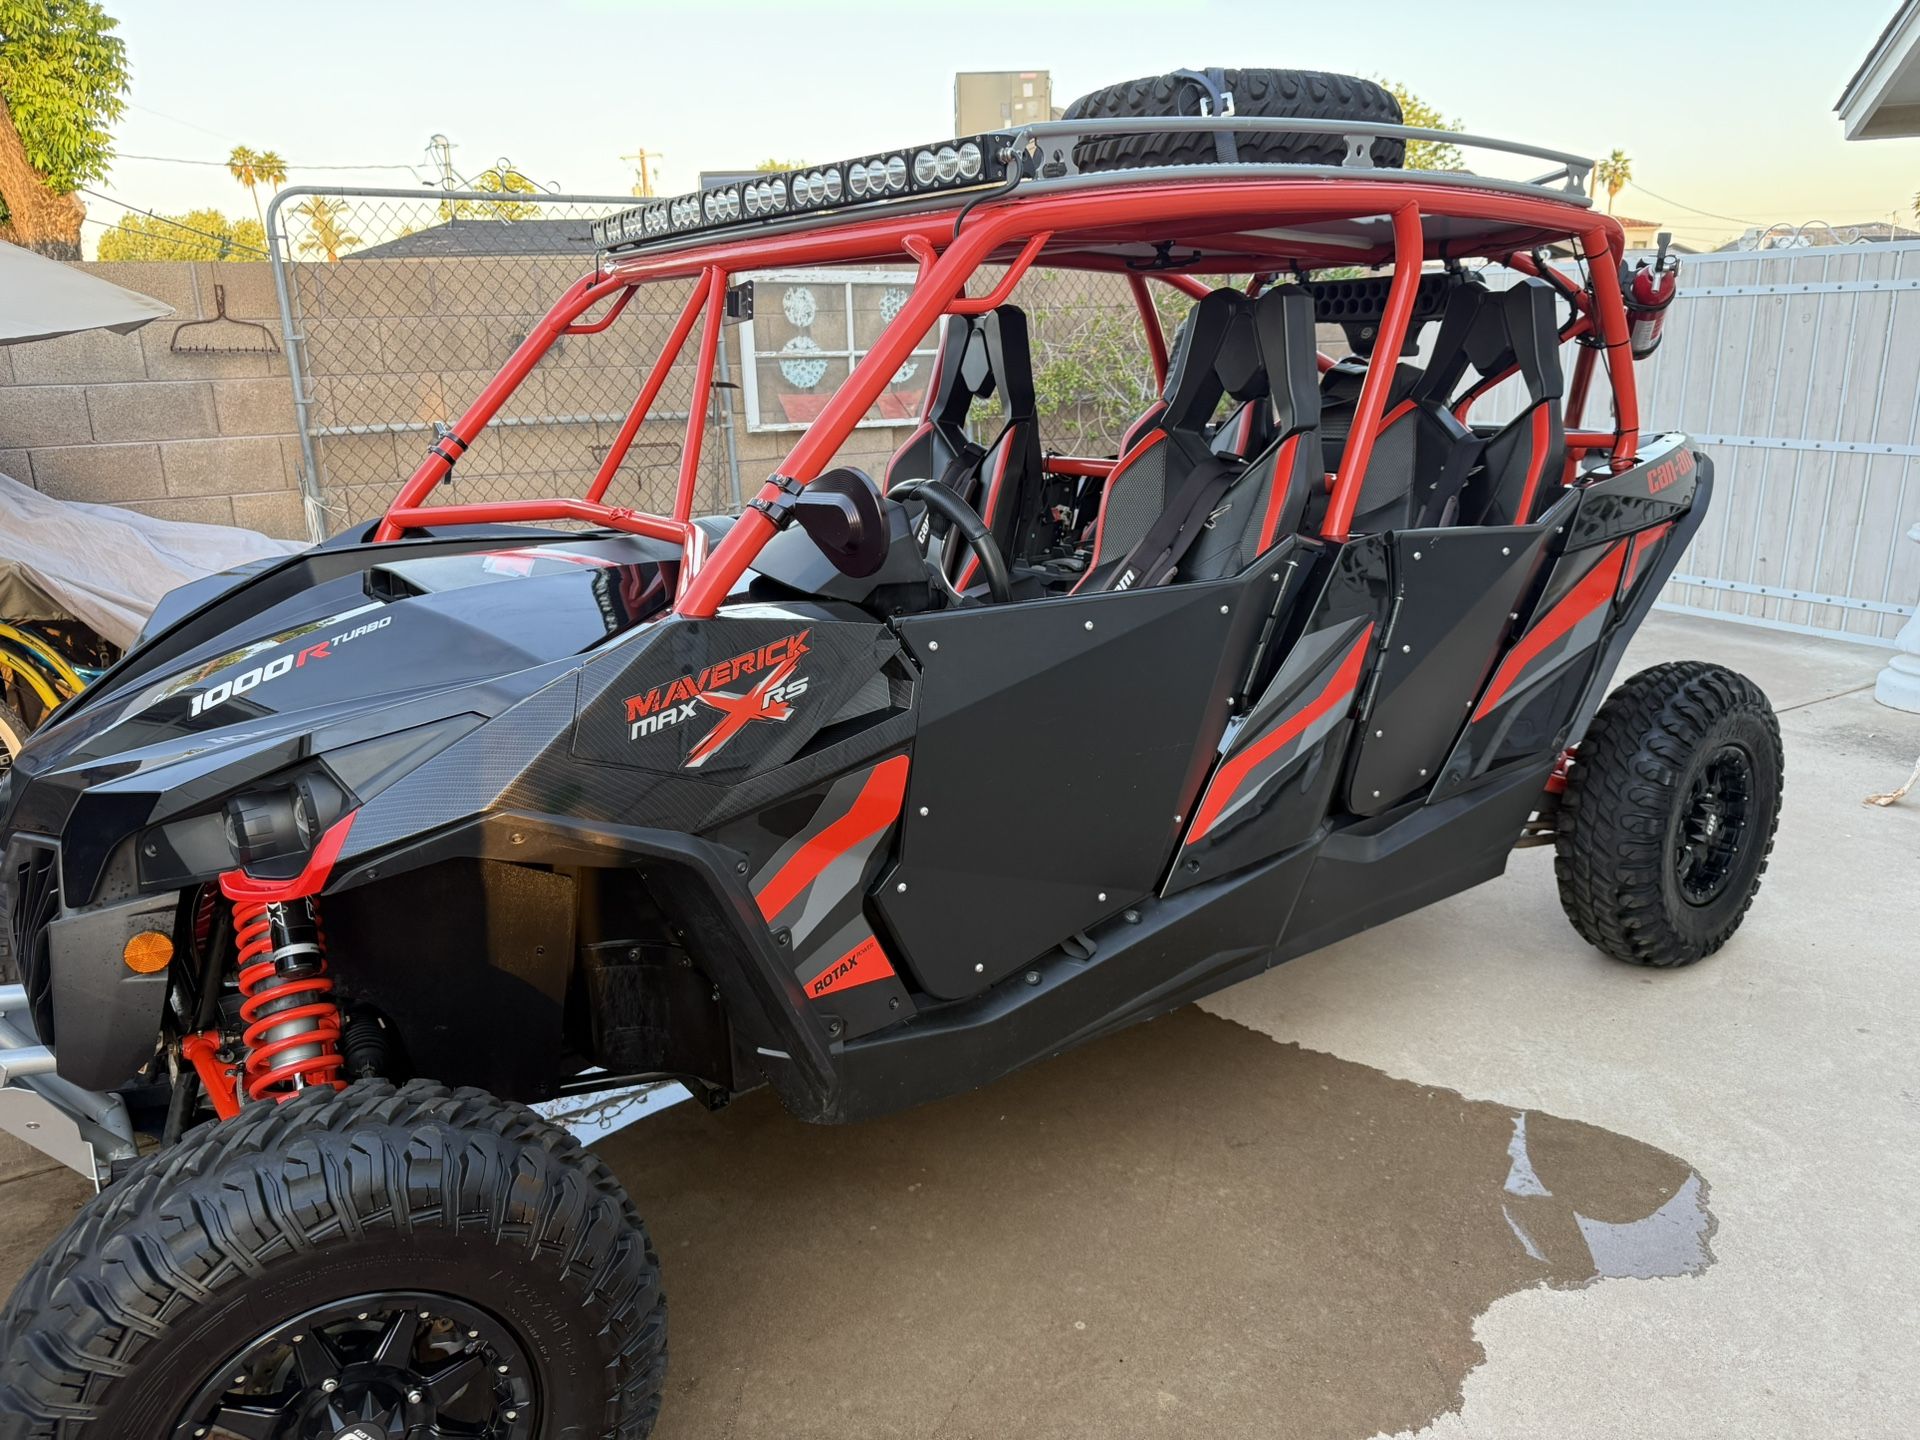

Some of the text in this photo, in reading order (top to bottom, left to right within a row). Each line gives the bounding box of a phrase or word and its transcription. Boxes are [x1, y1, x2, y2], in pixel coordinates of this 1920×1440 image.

[331, 616, 392, 647] TURBO
[624, 628, 811, 722] MAVERICK
[631, 699, 698, 741] MAX
[762, 676, 810, 710] RS
[814, 954, 858, 995] ROTAX
